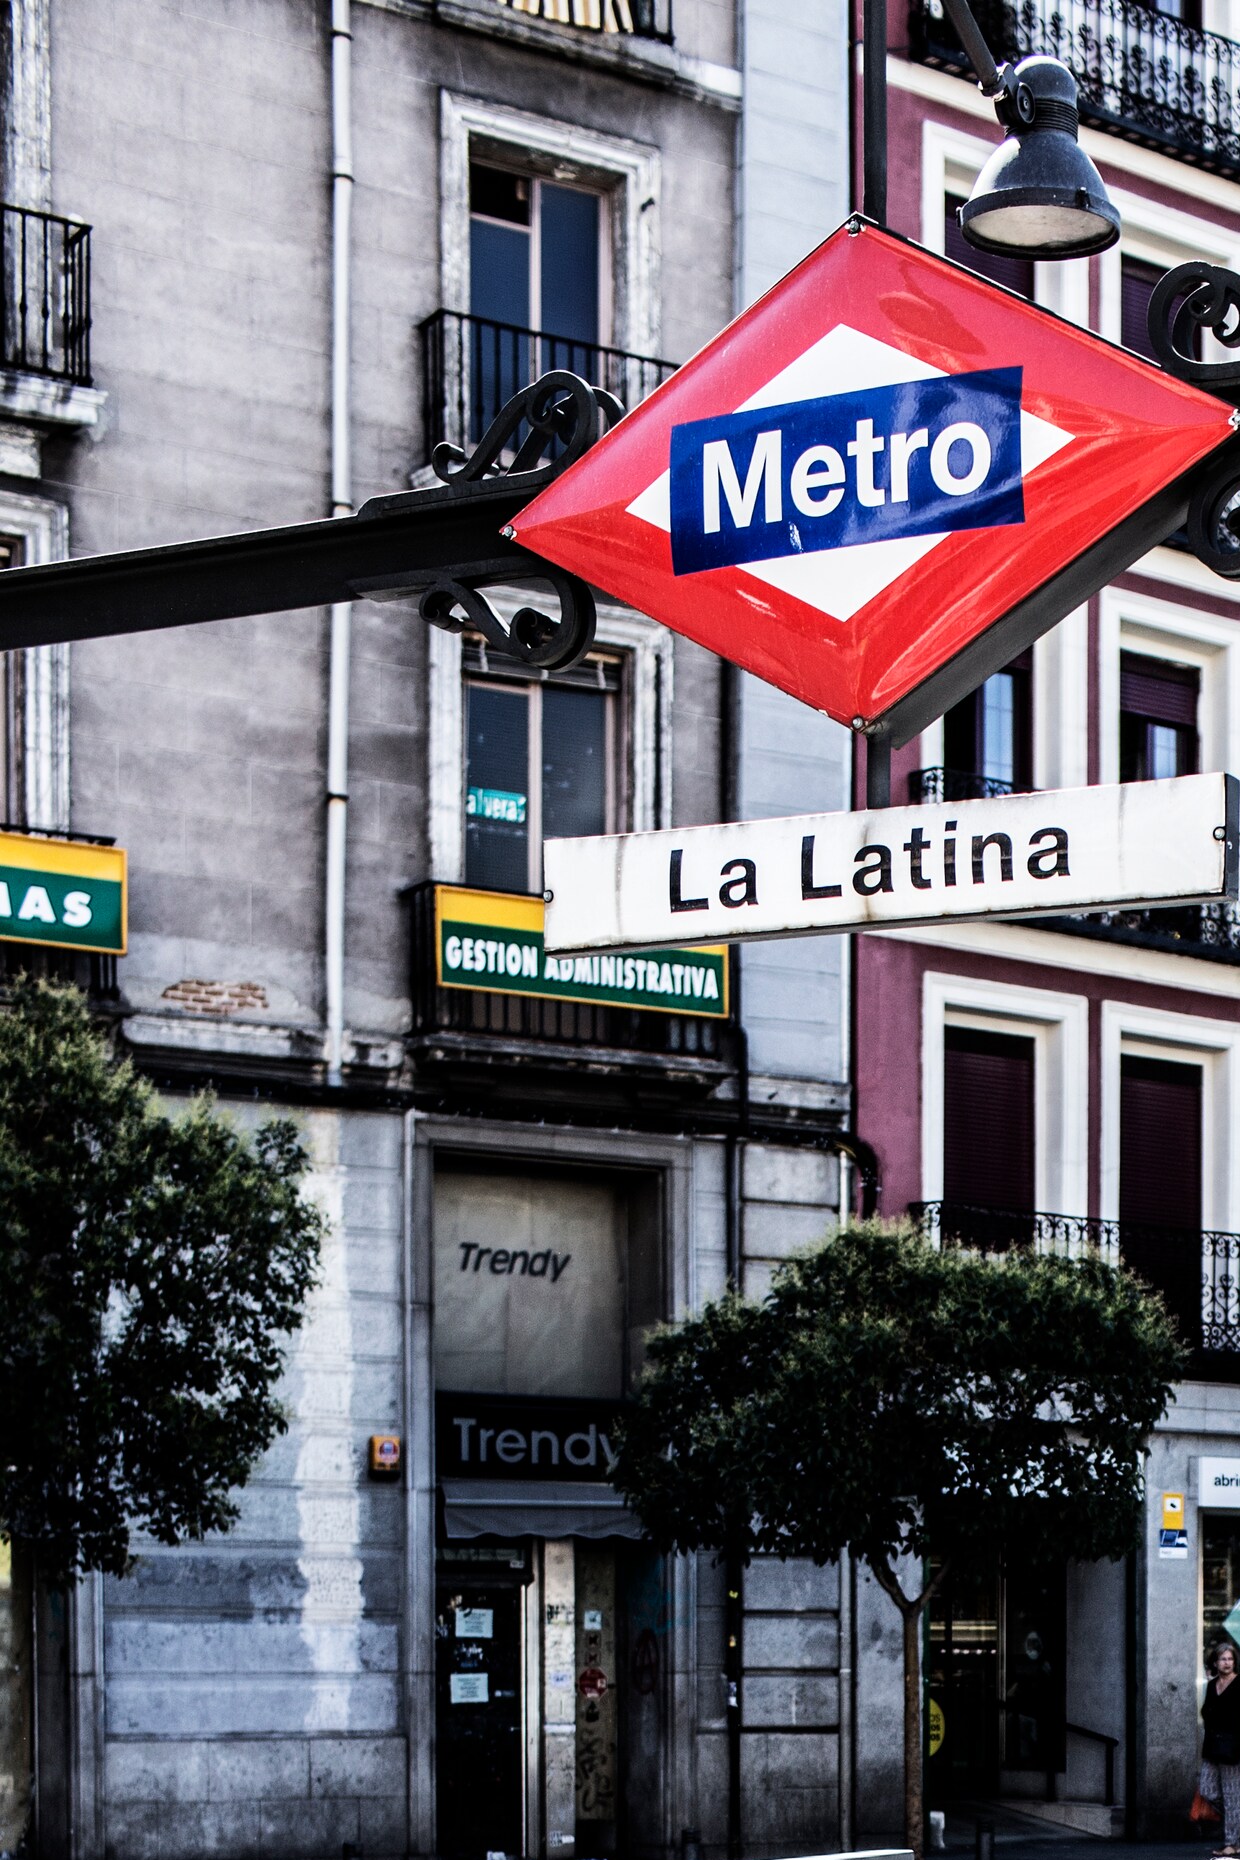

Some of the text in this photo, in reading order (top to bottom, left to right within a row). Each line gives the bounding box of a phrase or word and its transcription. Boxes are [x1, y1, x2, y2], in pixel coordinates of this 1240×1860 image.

[703, 418, 992, 535] Metro
[669, 819, 1071, 914] La Latina
[445, 936, 719, 1000] GESTION ADMINISTRATIVA
[459, 1241, 572, 1283] Trendy
[453, 1417, 620, 1477] Trendy
